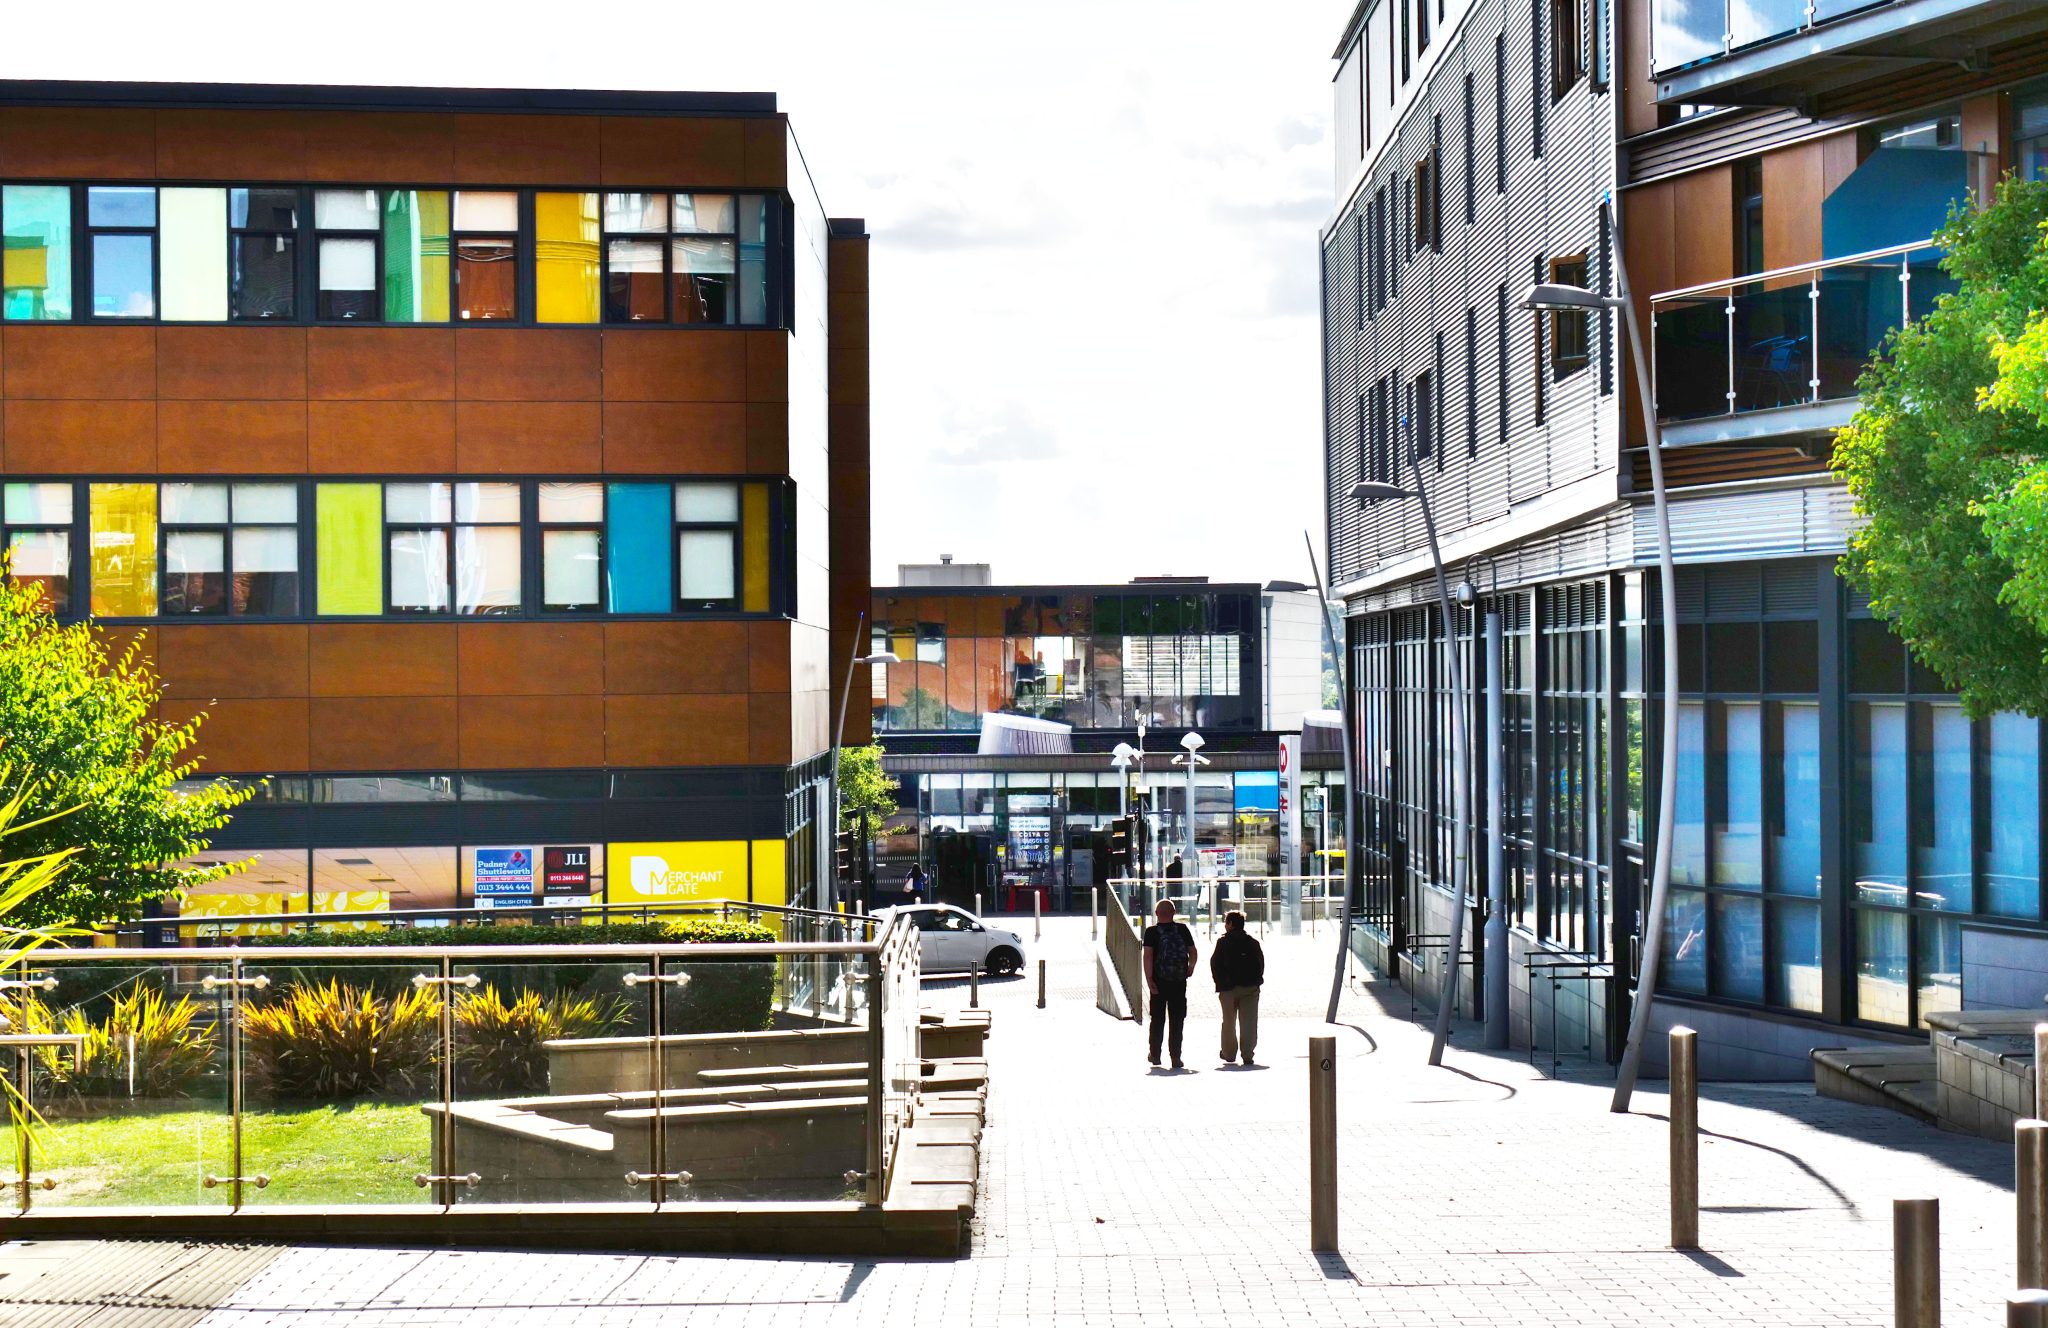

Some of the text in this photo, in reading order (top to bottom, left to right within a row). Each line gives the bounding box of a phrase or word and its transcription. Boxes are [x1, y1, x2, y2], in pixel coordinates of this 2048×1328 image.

[478, 861, 508, 869] Pudney
[564, 853, 586, 866] JLL
[649, 869, 724, 890] MERCHANT
[668, 882, 699, 895] GATE
